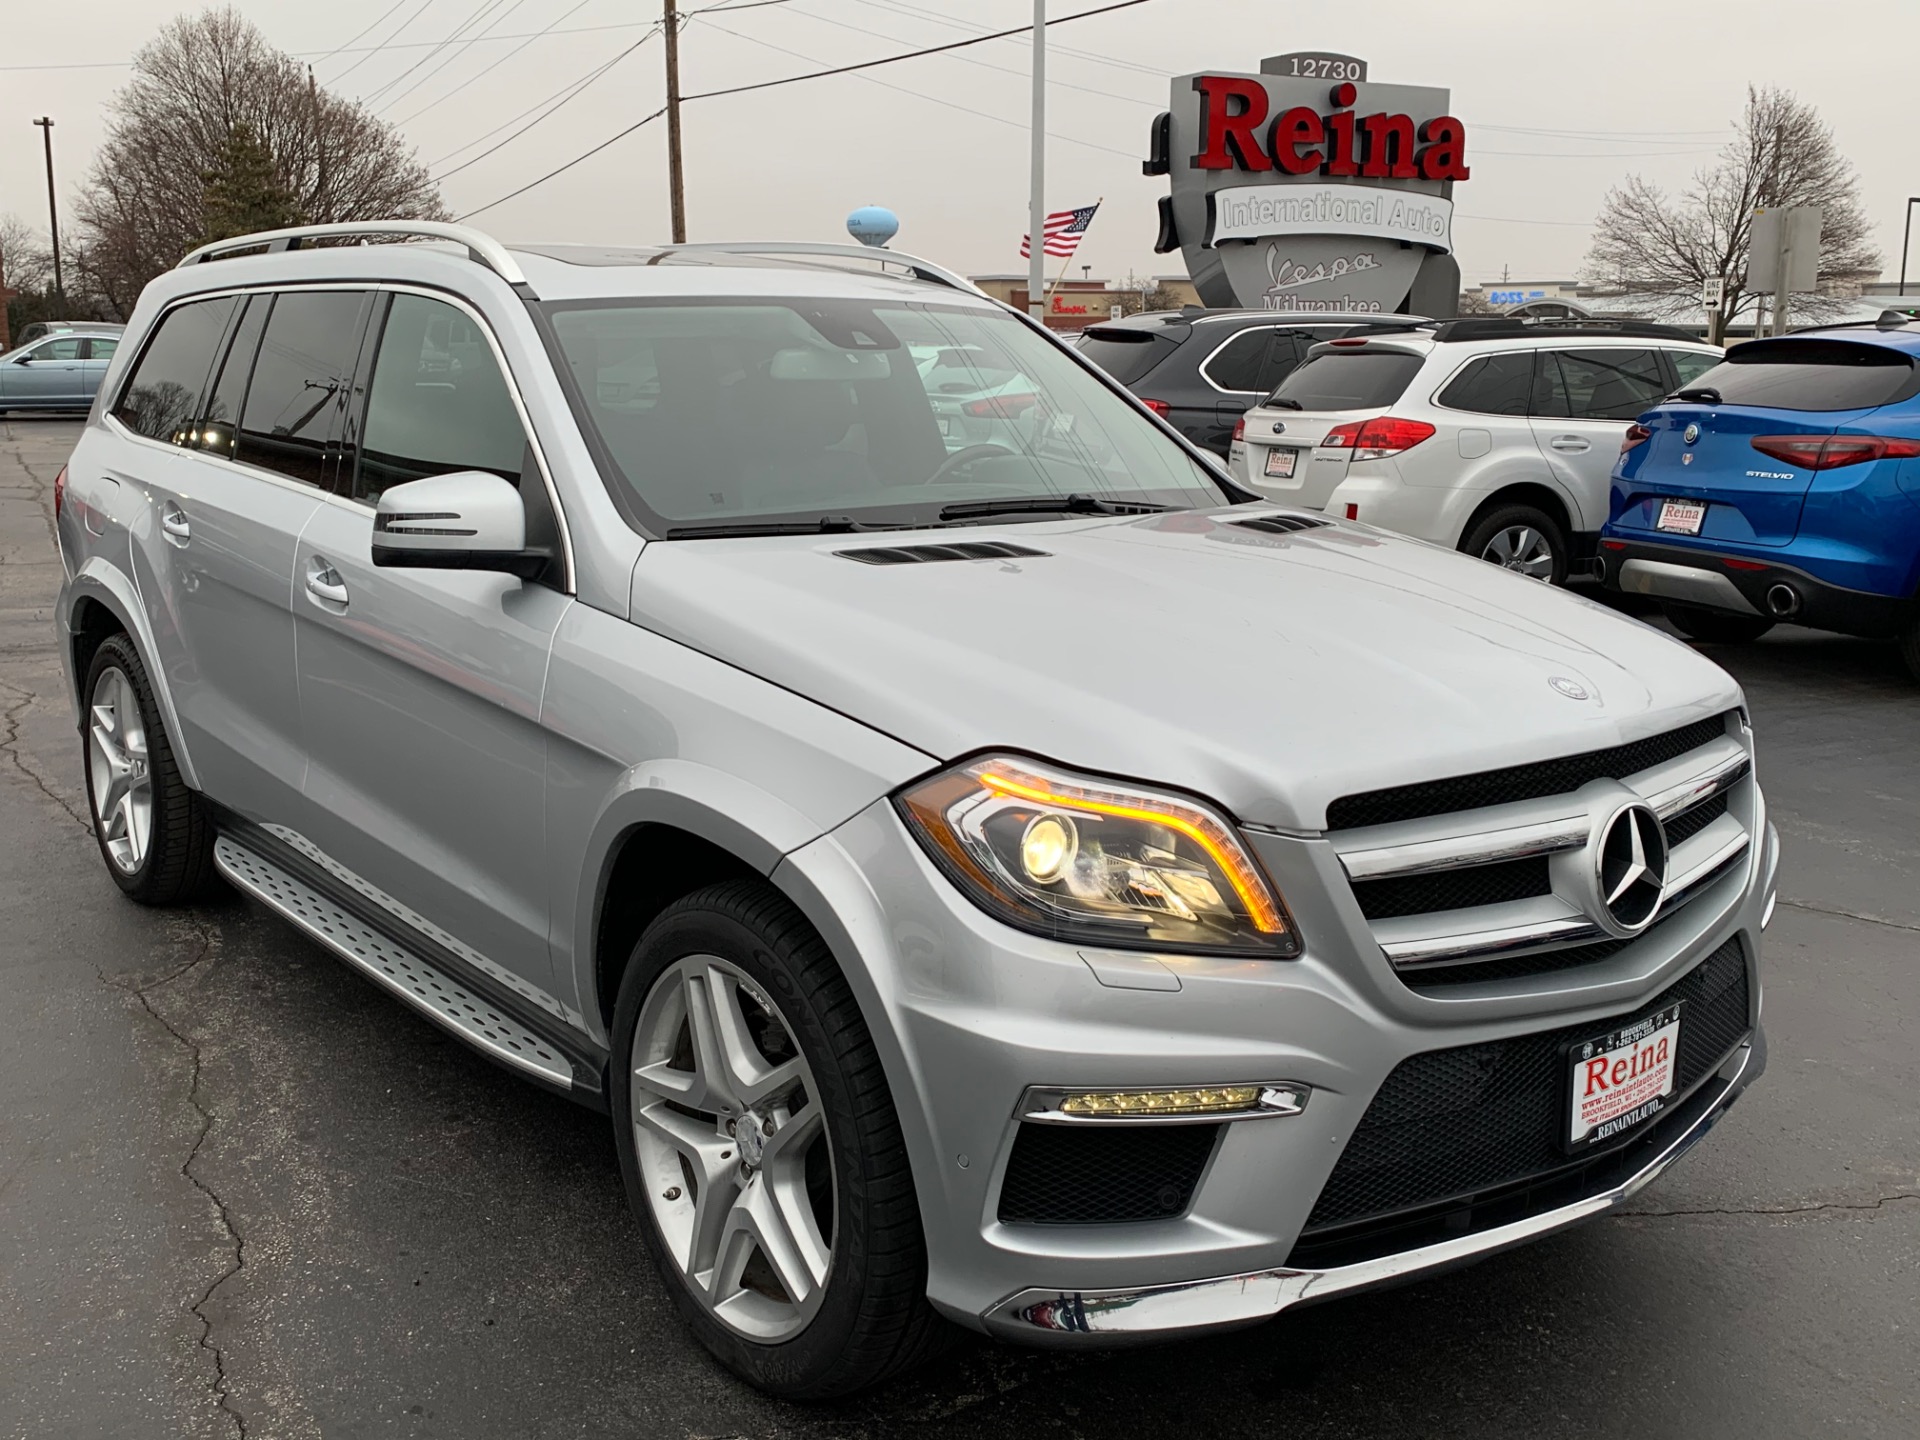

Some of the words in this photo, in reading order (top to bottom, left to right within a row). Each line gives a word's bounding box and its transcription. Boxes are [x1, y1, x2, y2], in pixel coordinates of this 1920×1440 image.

[1290, 57, 1361, 80] 12730
[1191, 76, 1471, 180] Reina
[1222, 191, 1384, 229] International
[1388, 198, 1445, 237] Auto
[1266, 242, 1382, 293] Vespa
[1706, 280, 1721, 289] ONE
[1490, 291, 1524, 304] ROSS
[1706, 290, 1720, 298] WAY
[1262, 294, 1382, 313] Milwaukee
[1270, 453, 1293, 466] Reina
[1745, 470, 1795, 480] STELVIO
[1664, 505, 1699, 520] Reina
[1583, 1036, 1669, 1098] Reina
